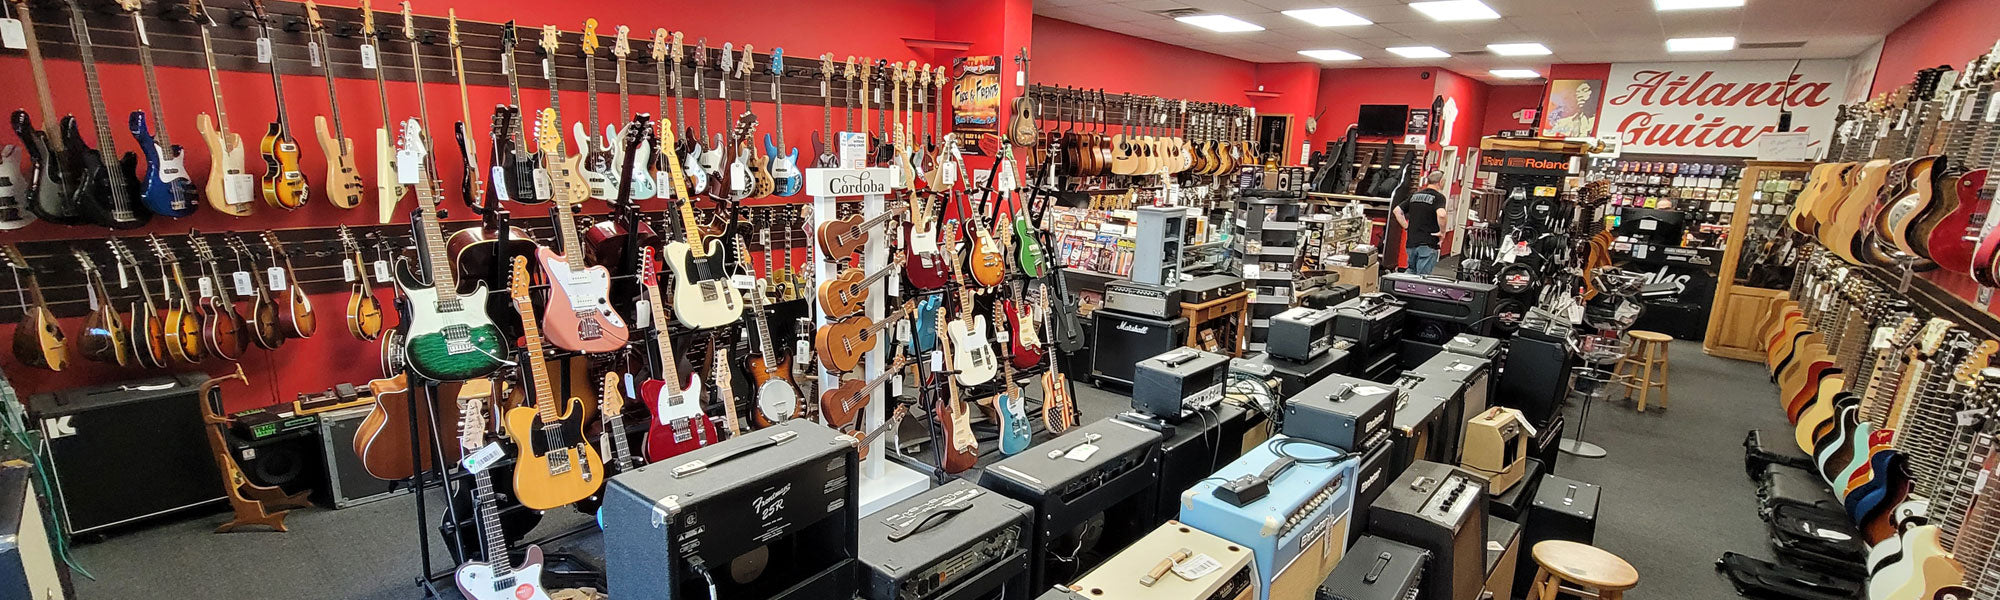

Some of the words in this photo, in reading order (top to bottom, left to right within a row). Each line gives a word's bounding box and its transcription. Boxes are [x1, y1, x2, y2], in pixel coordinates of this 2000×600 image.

[1609, 70, 1832, 107] Atlanta
[1616, 111, 1821, 148] Guitar
[1116, 320, 1149, 334] Marshall
[762, 499, 784, 520] 25R
